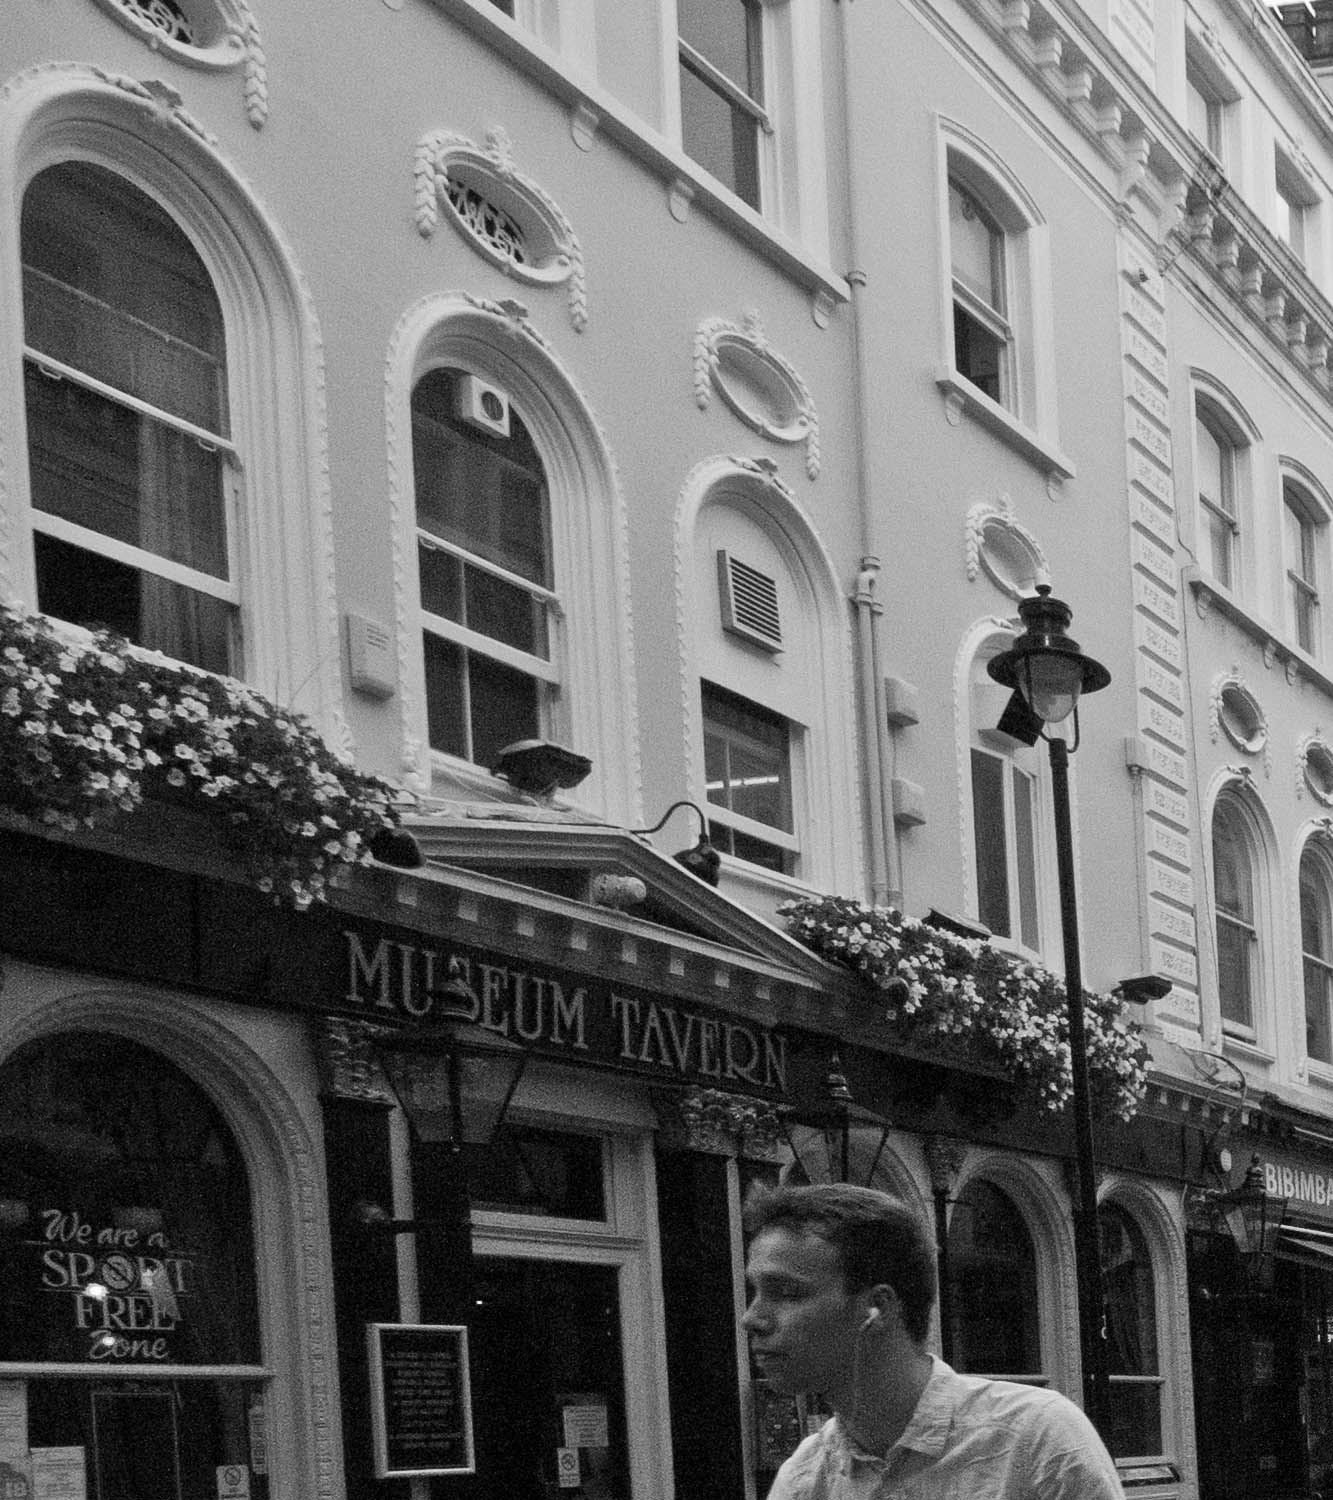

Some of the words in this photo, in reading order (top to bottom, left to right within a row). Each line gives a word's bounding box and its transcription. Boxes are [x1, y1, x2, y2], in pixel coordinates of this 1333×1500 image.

[343, 929, 591, 1051] MUSEUM
[610, 992, 788, 1095] TAVERN
[41, 1208, 93, 1245] We
[97, 1227, 140, 1248] are
[147, 1231, 170, 1248] a
[76, 1295, 177, 1331] FREE
[89, 1328, 170, 1360] Zone
